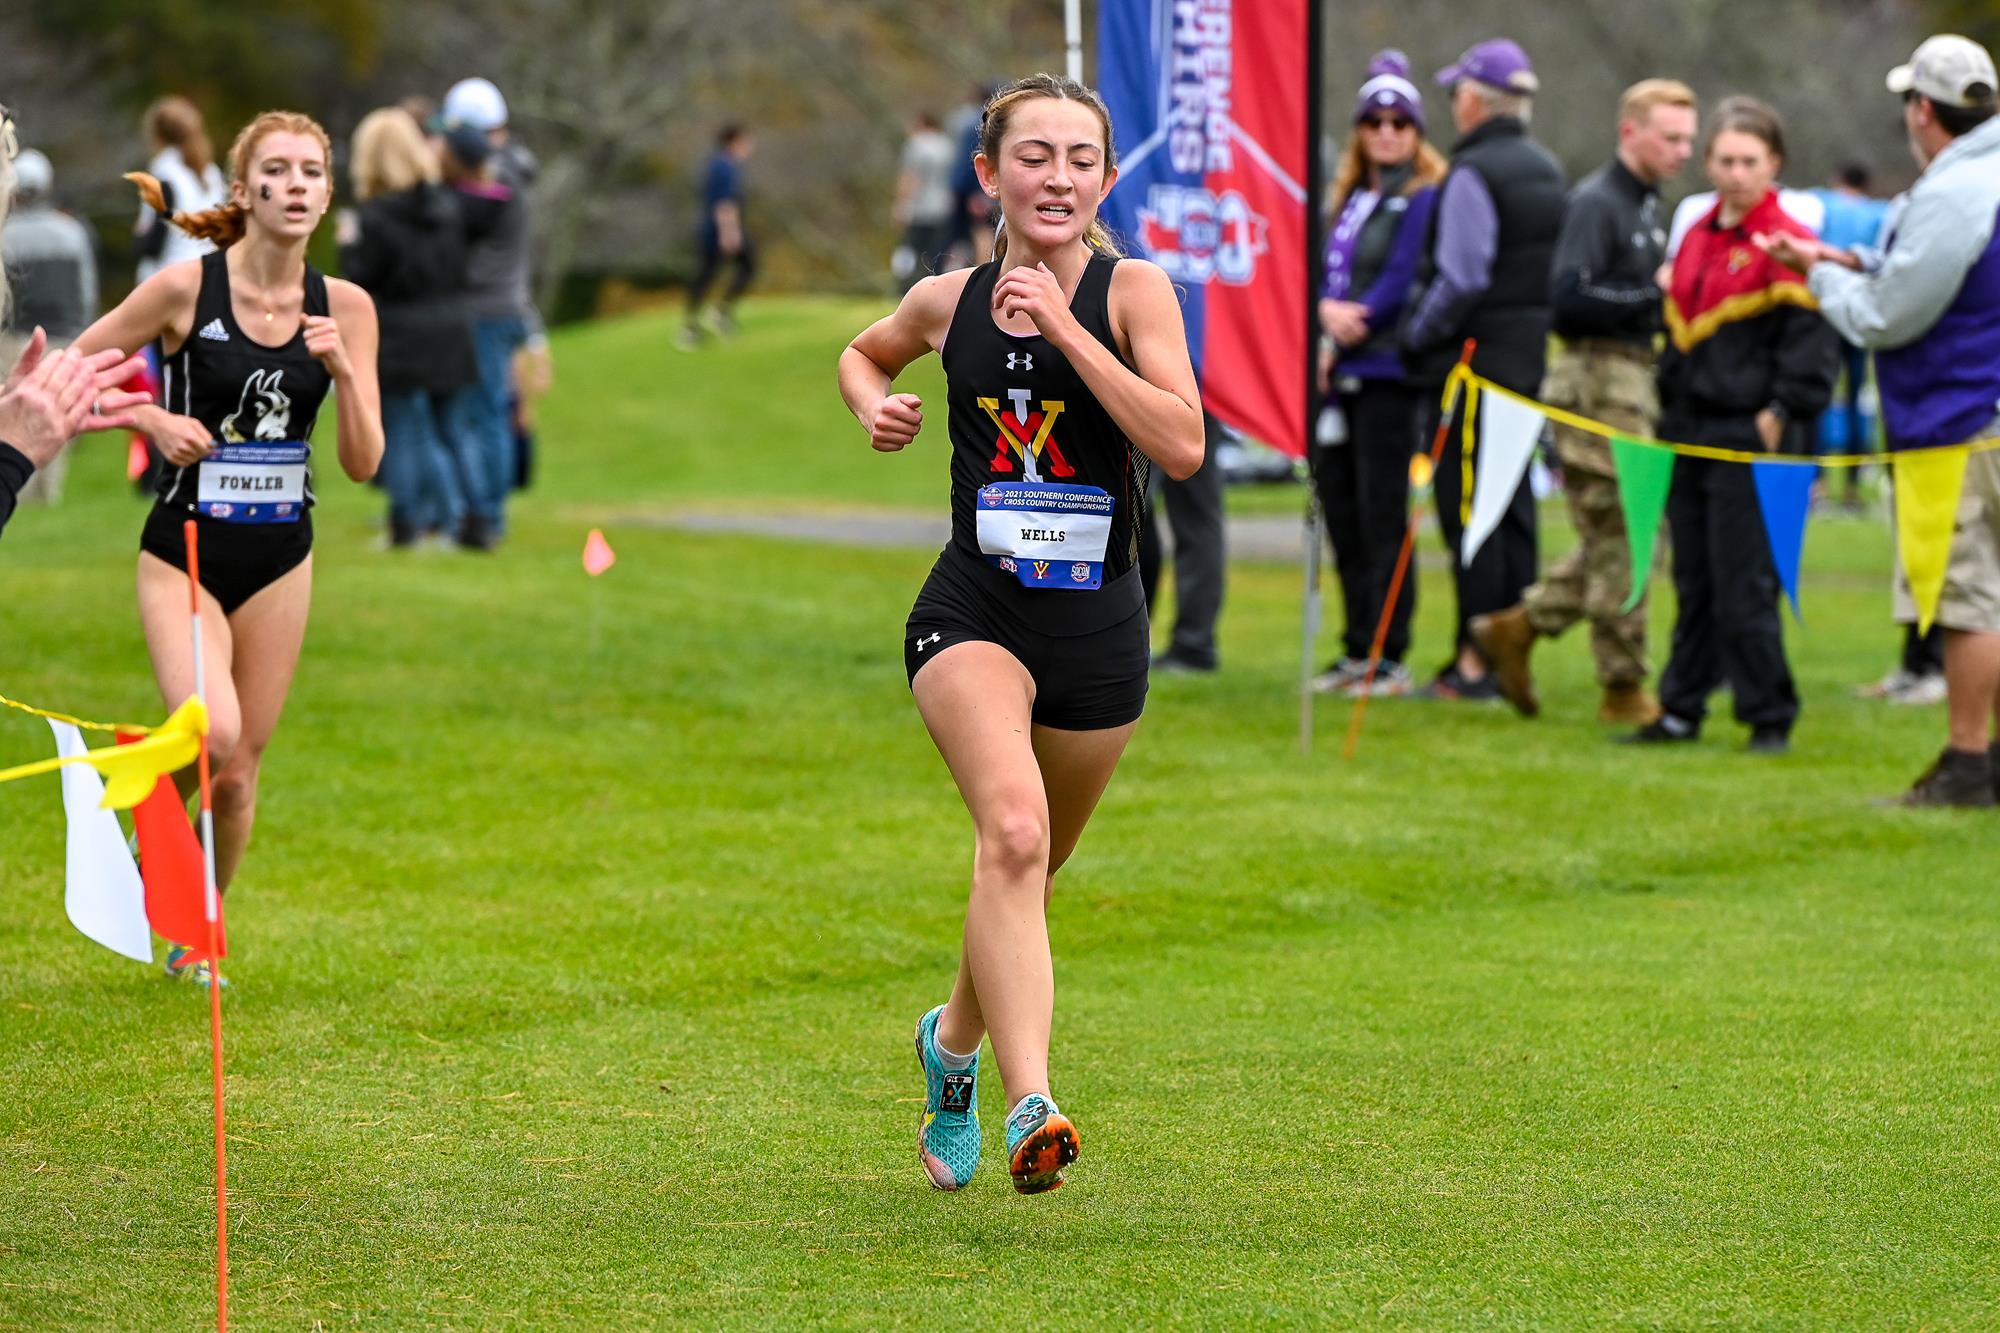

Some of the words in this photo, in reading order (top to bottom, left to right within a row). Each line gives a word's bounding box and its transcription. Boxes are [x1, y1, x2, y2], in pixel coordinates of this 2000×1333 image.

[219, 475, 284, 490] FOWLER
[1004, 490, 1022, 498] 2021
[1023, 490, 1064, 501] SOUTHERN
[1064, 493, 1111, 504] CONFERENCE
[1003, 498, 1025, 506] CROSS
[1025, 499, 1058, 509] COUNTRY
[1057, 501, 1111, 512] CHAMPIONSHIPS
[1021, 528, 1066, 542] WELLS
